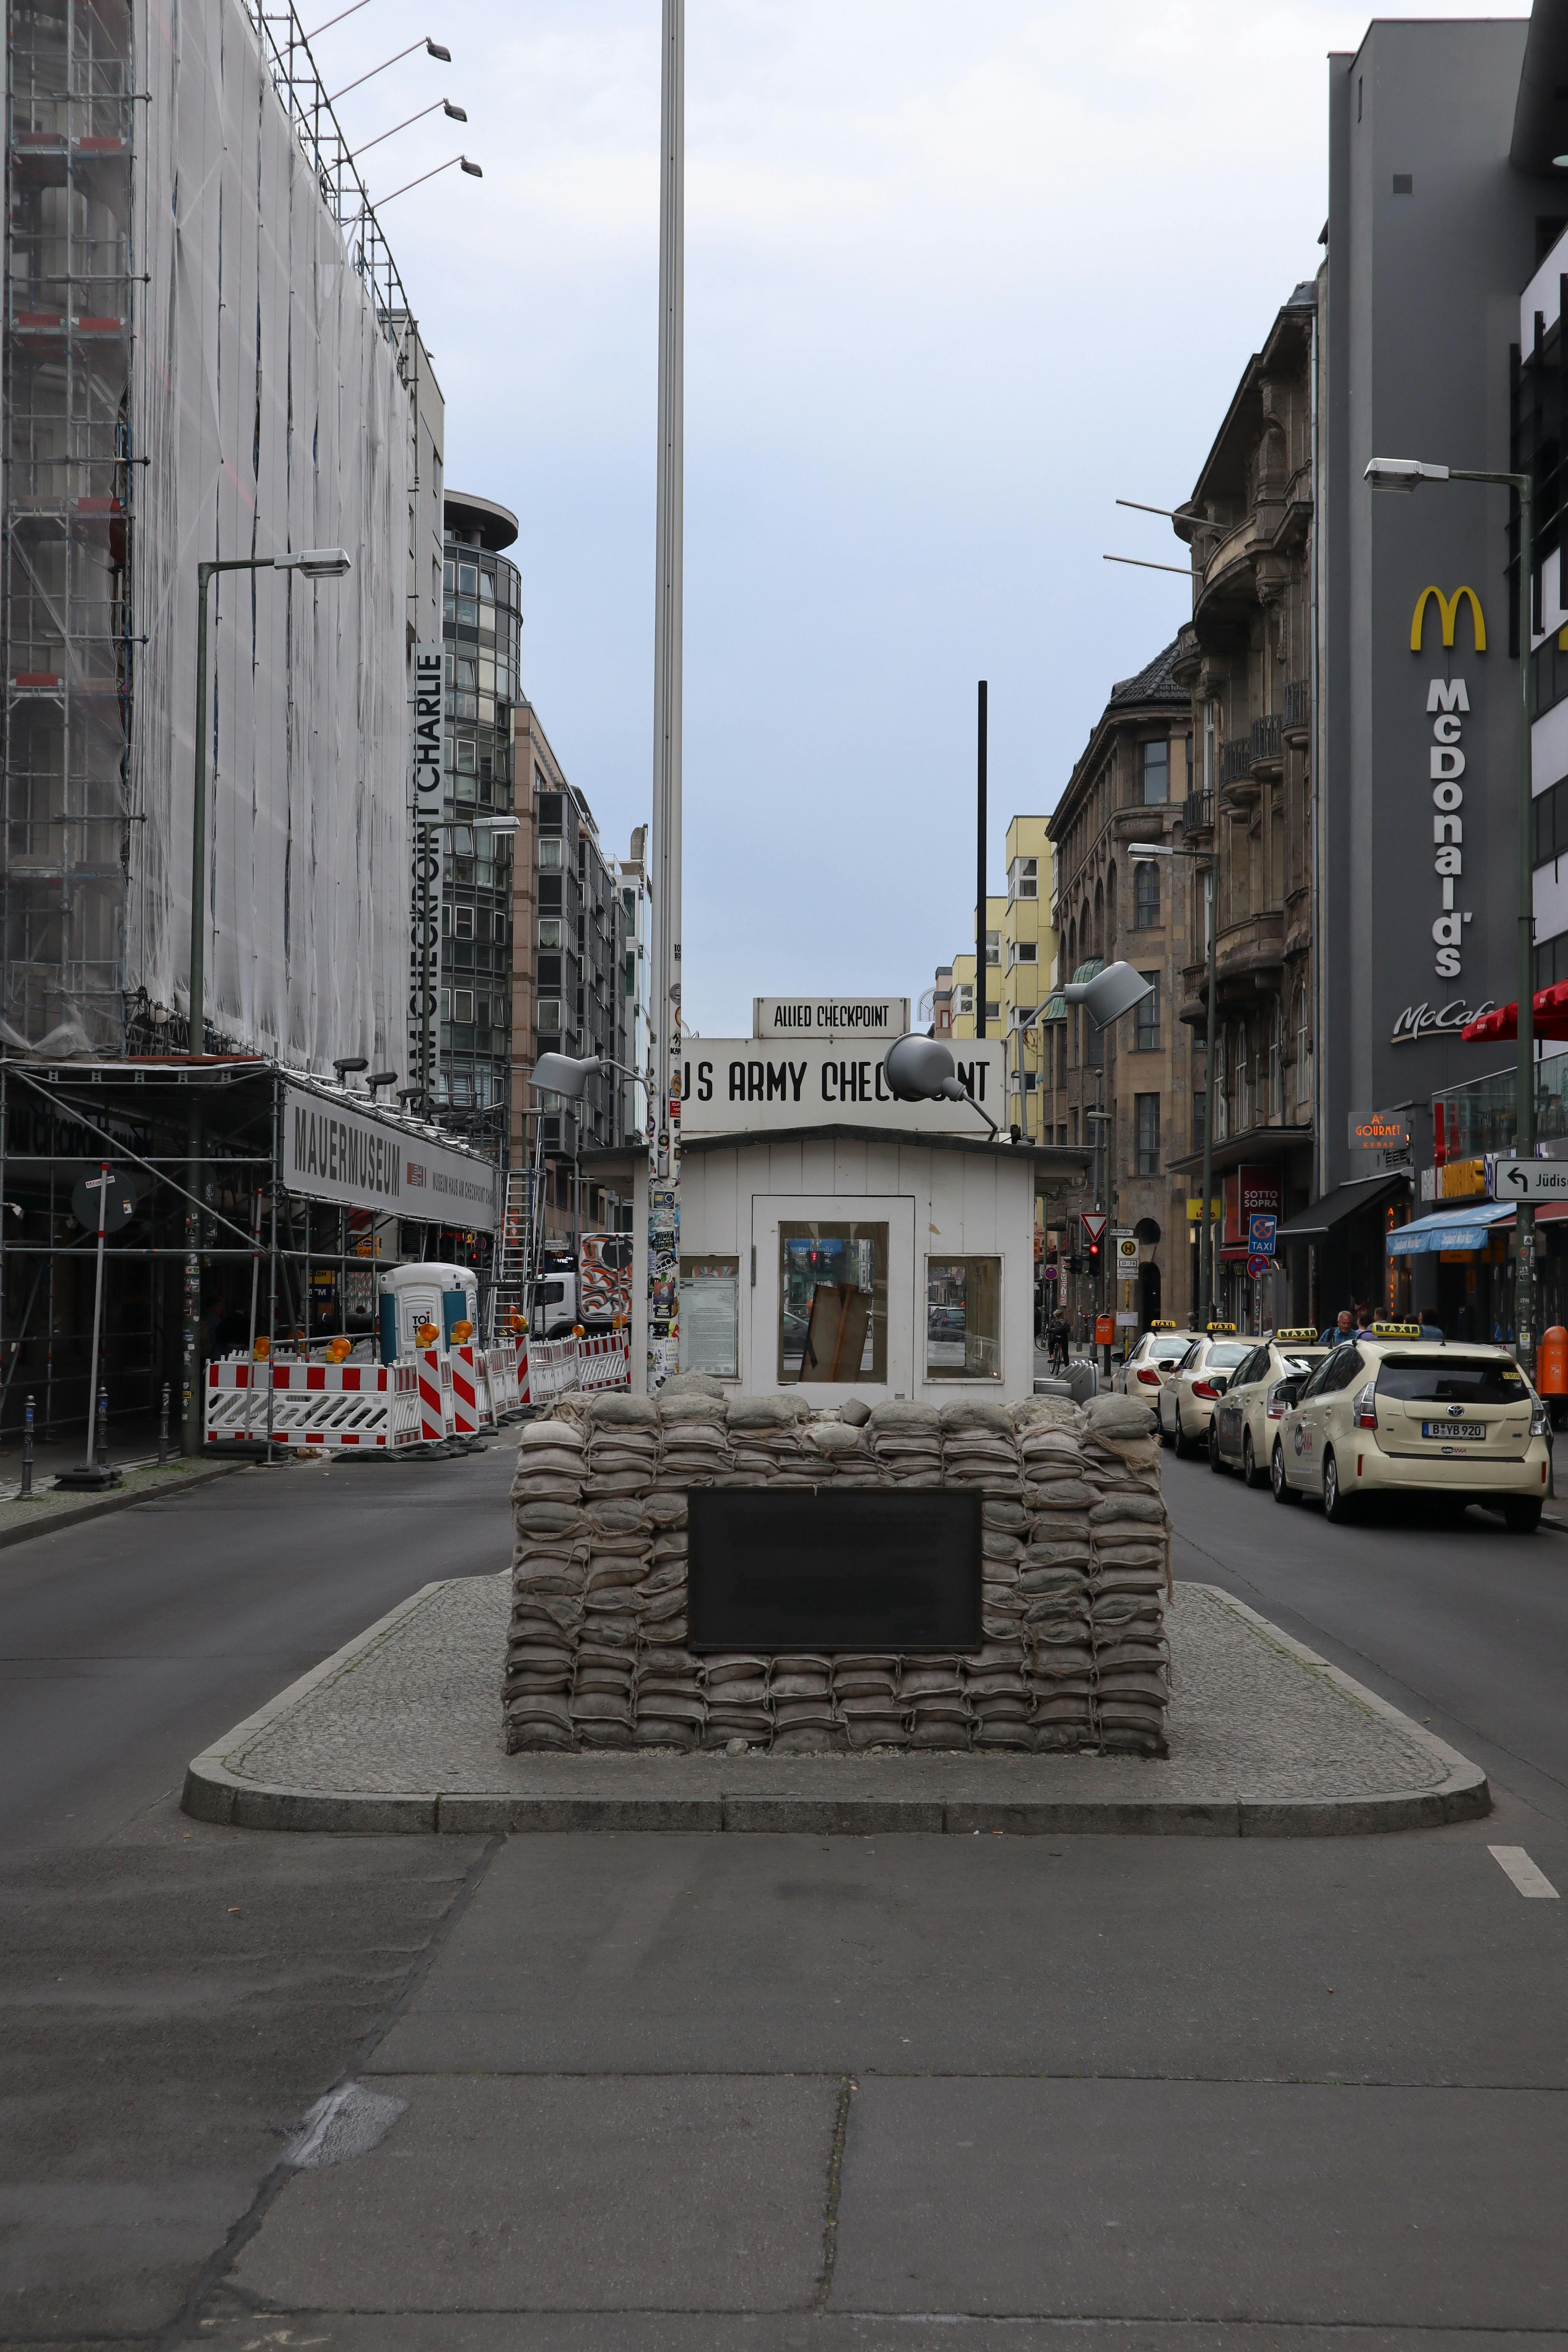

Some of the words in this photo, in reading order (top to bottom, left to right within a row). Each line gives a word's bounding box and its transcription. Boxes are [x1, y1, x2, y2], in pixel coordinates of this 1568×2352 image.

[413, 655, 441, 792] CHARLIE
[1426, 679, 1473, 977] McDonald's
[774, 1005, 811, 1027] ALLIED
[817, 1005, 889, 1027] CHECKPOINT
[1393, 999, 1495, 1040] McCaf
[730, 1061, 808, 1102] ARMY
[822, 1061, 990, 1102] CHECNT
[1356, 1125, 1401, 1136] GOURMET
[295, 1106, 400, 1197] MAUERMUSEUM
[433, 1172, 448, 1194] MUSEUM
[449, 1176, 458, 1197] HAUS
[459, 1180, 464, 1198] AM
[465, 1181, 485, 1203] CHECKPOINT
[1244, 1191, 1278, 1199] SOTTO
[1244, 1200, 1278, 1208] SOPRA
[1125, 1244, 1132, 1253] H
[1252, 1241, 1273, 1251] TAXI
[655, 1262, 675, 1275] coconut
[1380, 1325, 1414, 1333] TAXI
[1433, 1425, 1439, 1435] B
[1446, 1425, 1460, 1436] YB
[1462, 1426, 1481, 1436] 920
